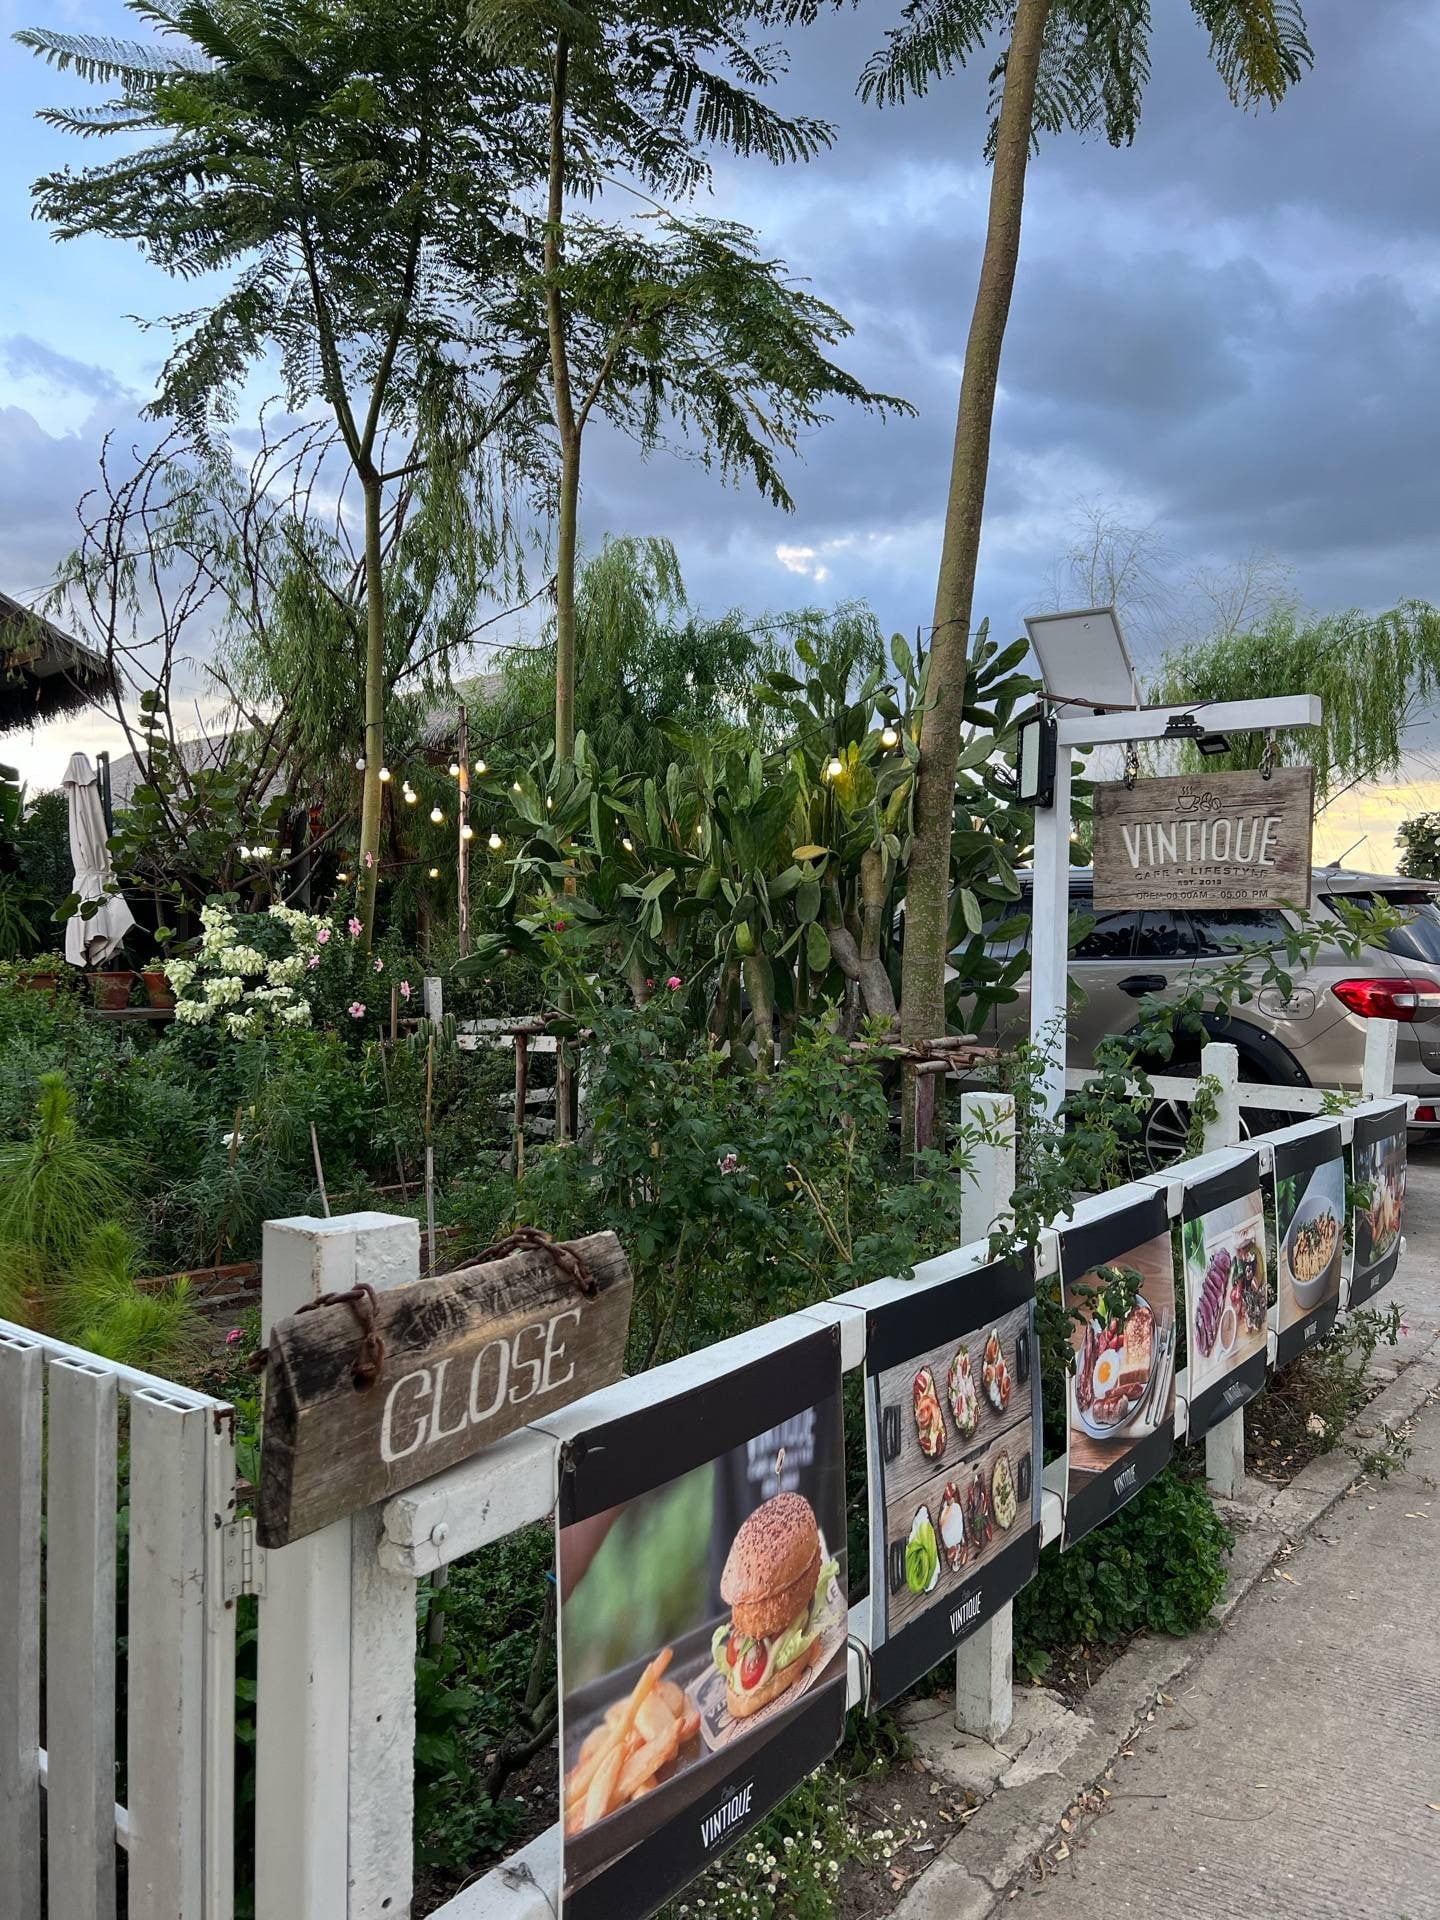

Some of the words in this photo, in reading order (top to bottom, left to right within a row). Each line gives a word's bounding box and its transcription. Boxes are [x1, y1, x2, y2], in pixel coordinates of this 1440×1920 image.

[1120, 815, 1283, 868] VINTIQUE
[1135, 869, 1170, 881] CAFE
[1252, 889, 1268, 898] PM
[380, 1307, 582, 1463] CLOSE
[950, 1591, 982, 1635] VINTIQUE
[701, 1782, 754, 1848] VINTIQUE
